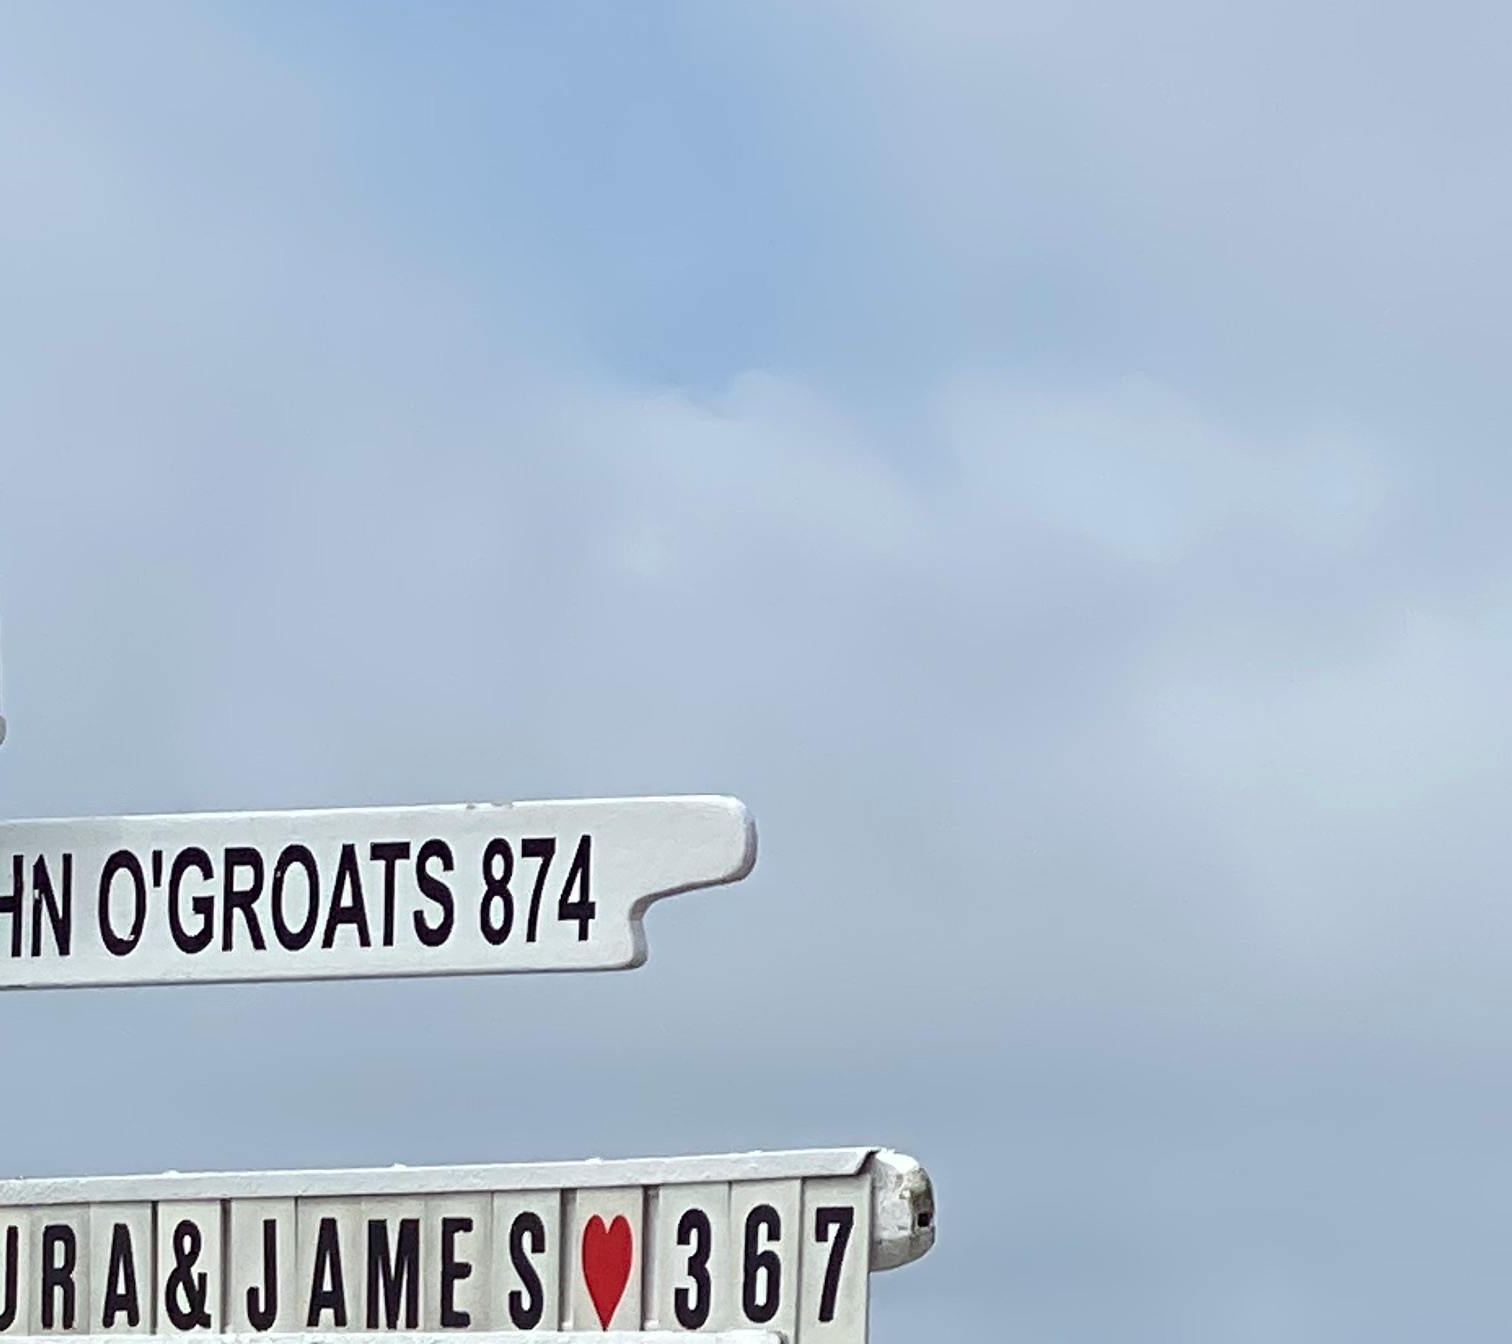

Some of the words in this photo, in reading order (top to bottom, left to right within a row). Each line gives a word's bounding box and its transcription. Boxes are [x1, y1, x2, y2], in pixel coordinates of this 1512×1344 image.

[98, 839, 455, 955] O'GROATS
[479, 833, 595, 946] 874
[673, 1204, 855, 1331] 367
